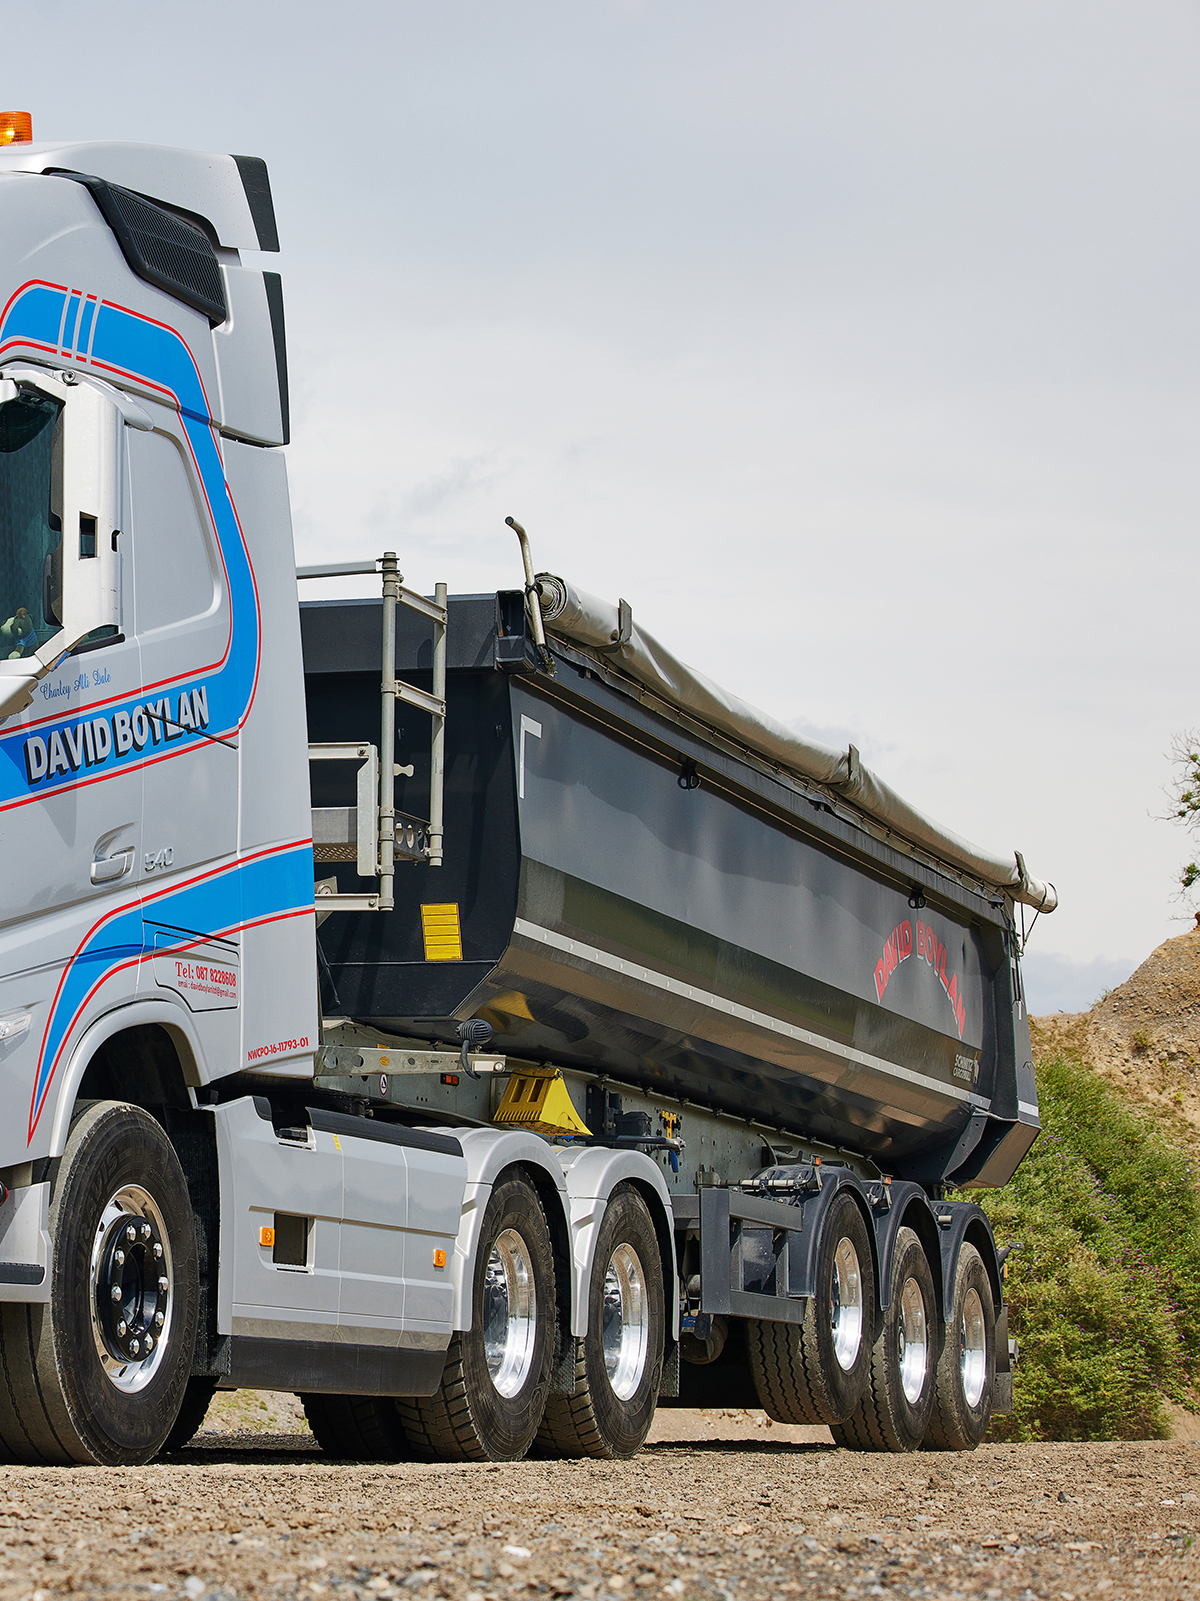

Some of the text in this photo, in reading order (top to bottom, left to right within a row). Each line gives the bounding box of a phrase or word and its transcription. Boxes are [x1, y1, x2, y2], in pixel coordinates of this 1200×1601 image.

[40, 680, 70, 700] Charley
[23, 685, 210, 786] DAVID BOYLAN
[145, 847, 174, 872] 540
[175, 961, 195, 979] Tel:
[195, 965, 209, 981] 087
[873, 919, 967, 1041] DAVID BOYLAN
